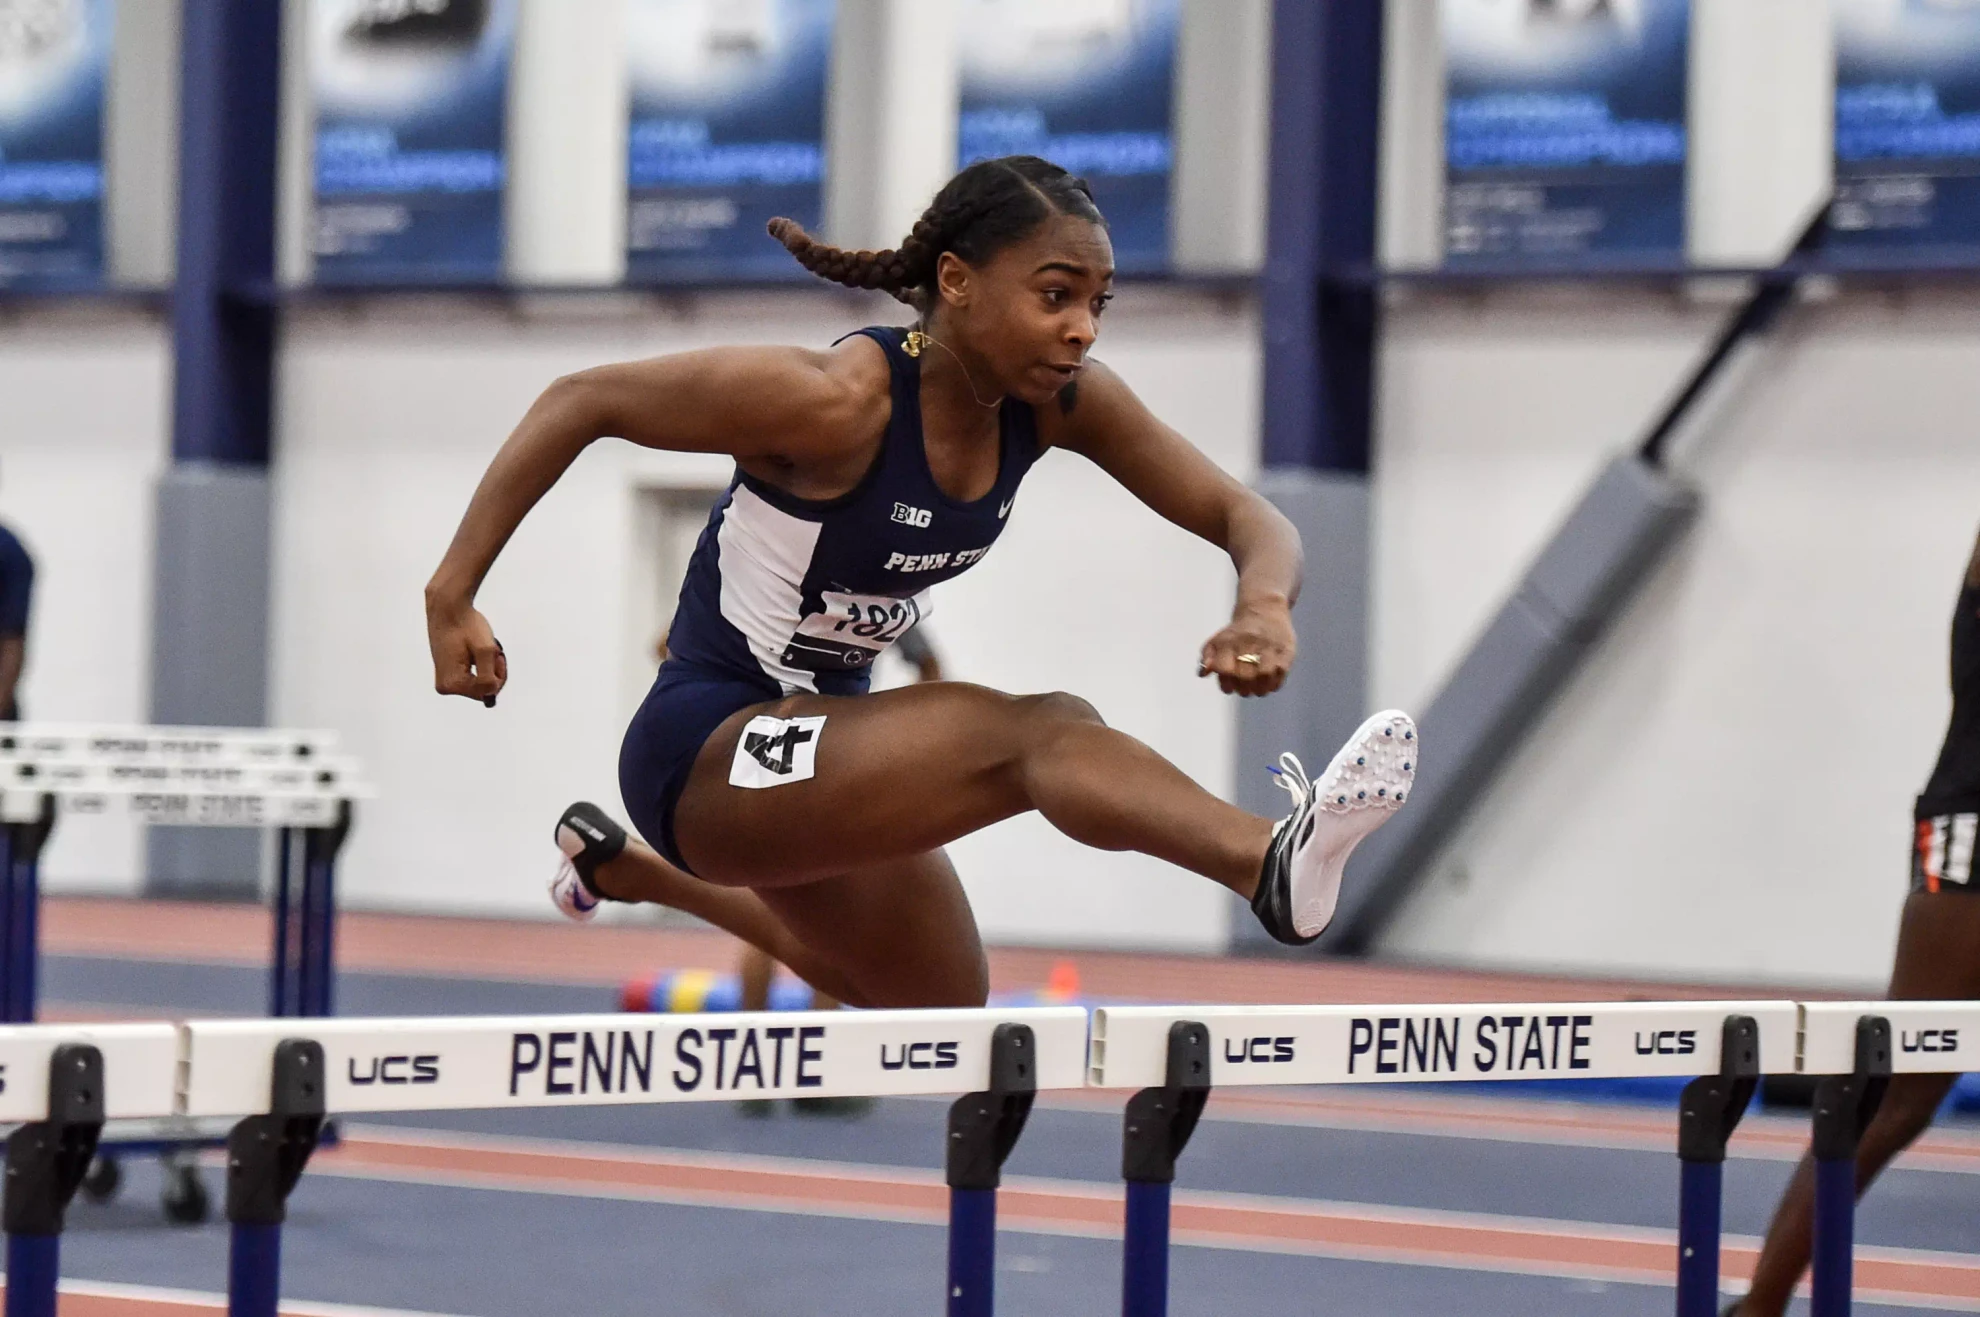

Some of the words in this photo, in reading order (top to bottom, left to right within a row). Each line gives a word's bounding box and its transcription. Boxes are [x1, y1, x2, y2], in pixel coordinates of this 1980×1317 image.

[883, 551, 951, 573] PENN
[744, 725, 814, 775] 4
[1225, 1037, 1296, 1063] UCS
[1348, 1017, 1460, 1074] PENN
[1474, 1016, 1593, 1072] STATE
[1635, 1030, 1698, 1055] UCS
[1902, 1030, 1959, 1052] UCS
[349, 1055, 440, 1085] UCS
[510, 1030, 653, 1096] PENN
[672, 1027, 825, 1092] STATE
[881, 1042, 959, 1070] UCS
